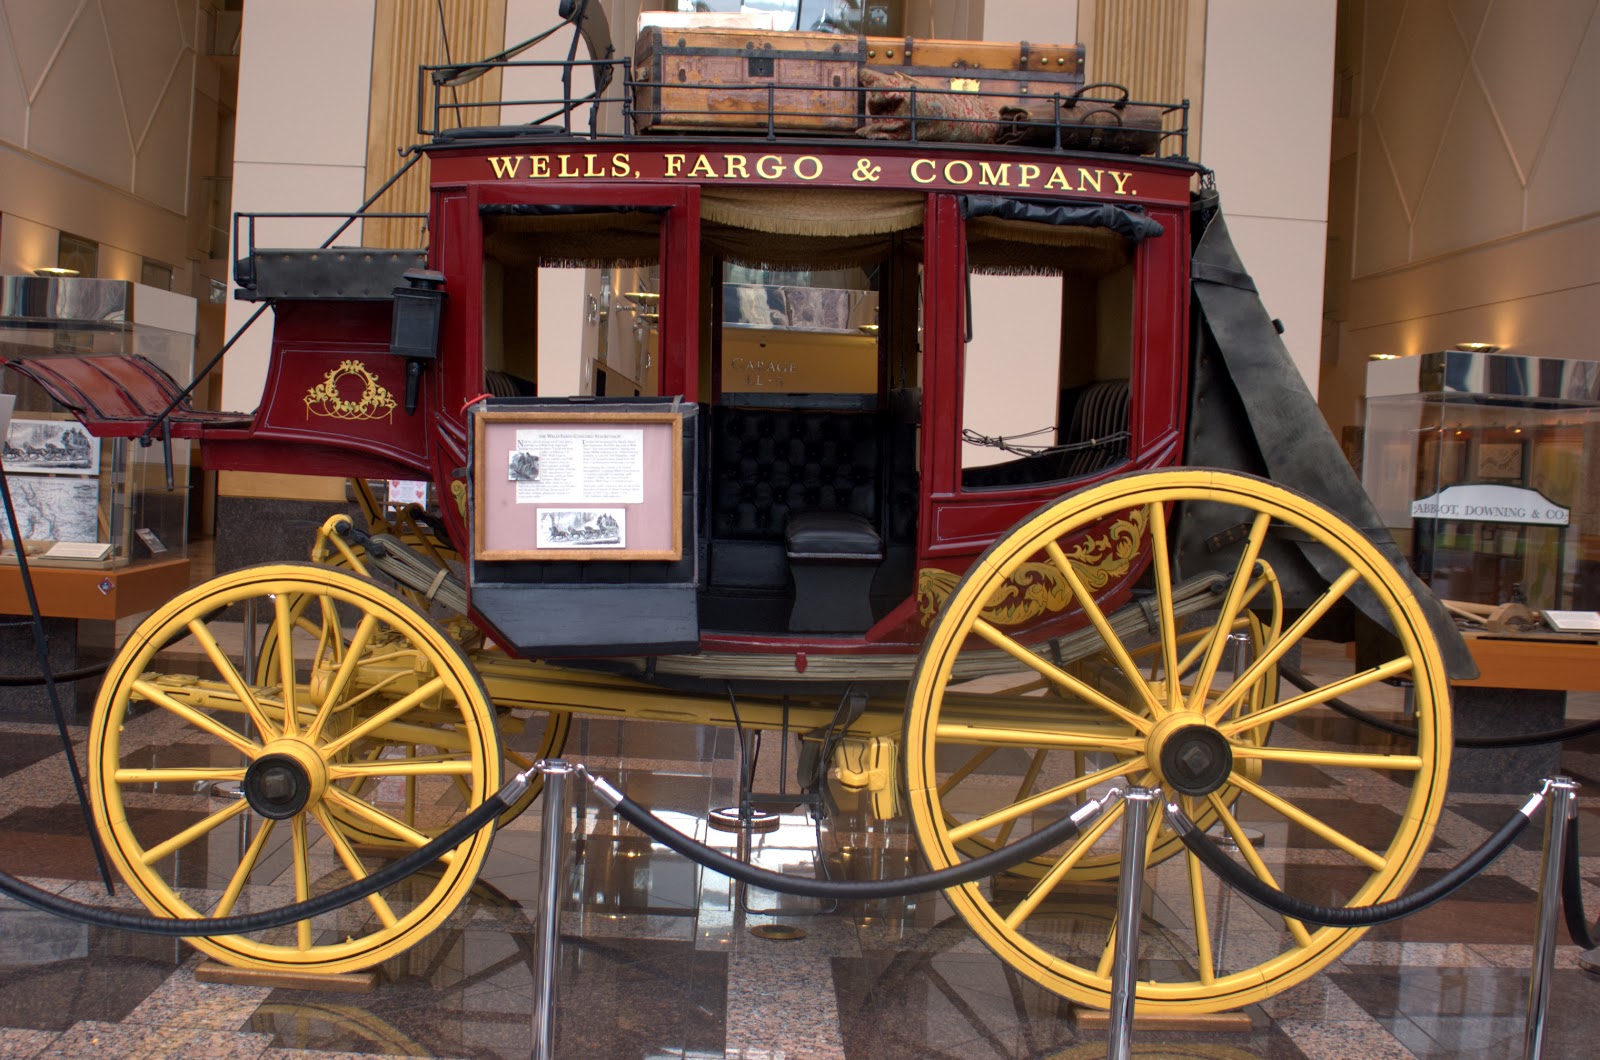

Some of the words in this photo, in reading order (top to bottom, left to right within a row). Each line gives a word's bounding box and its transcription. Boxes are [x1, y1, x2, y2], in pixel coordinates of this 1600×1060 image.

[487, 153, 641, 179] WELLS,
[663, 153, 824, 180] FARGO
[851, 157, 882, 182] &
[909, 158, 1138, 195] COMPANY.
[731, 357, 796, 373] GARAGE
[1465, 504, 1526, 518] DOWNING
[1531, 509, 1541, 519] &
